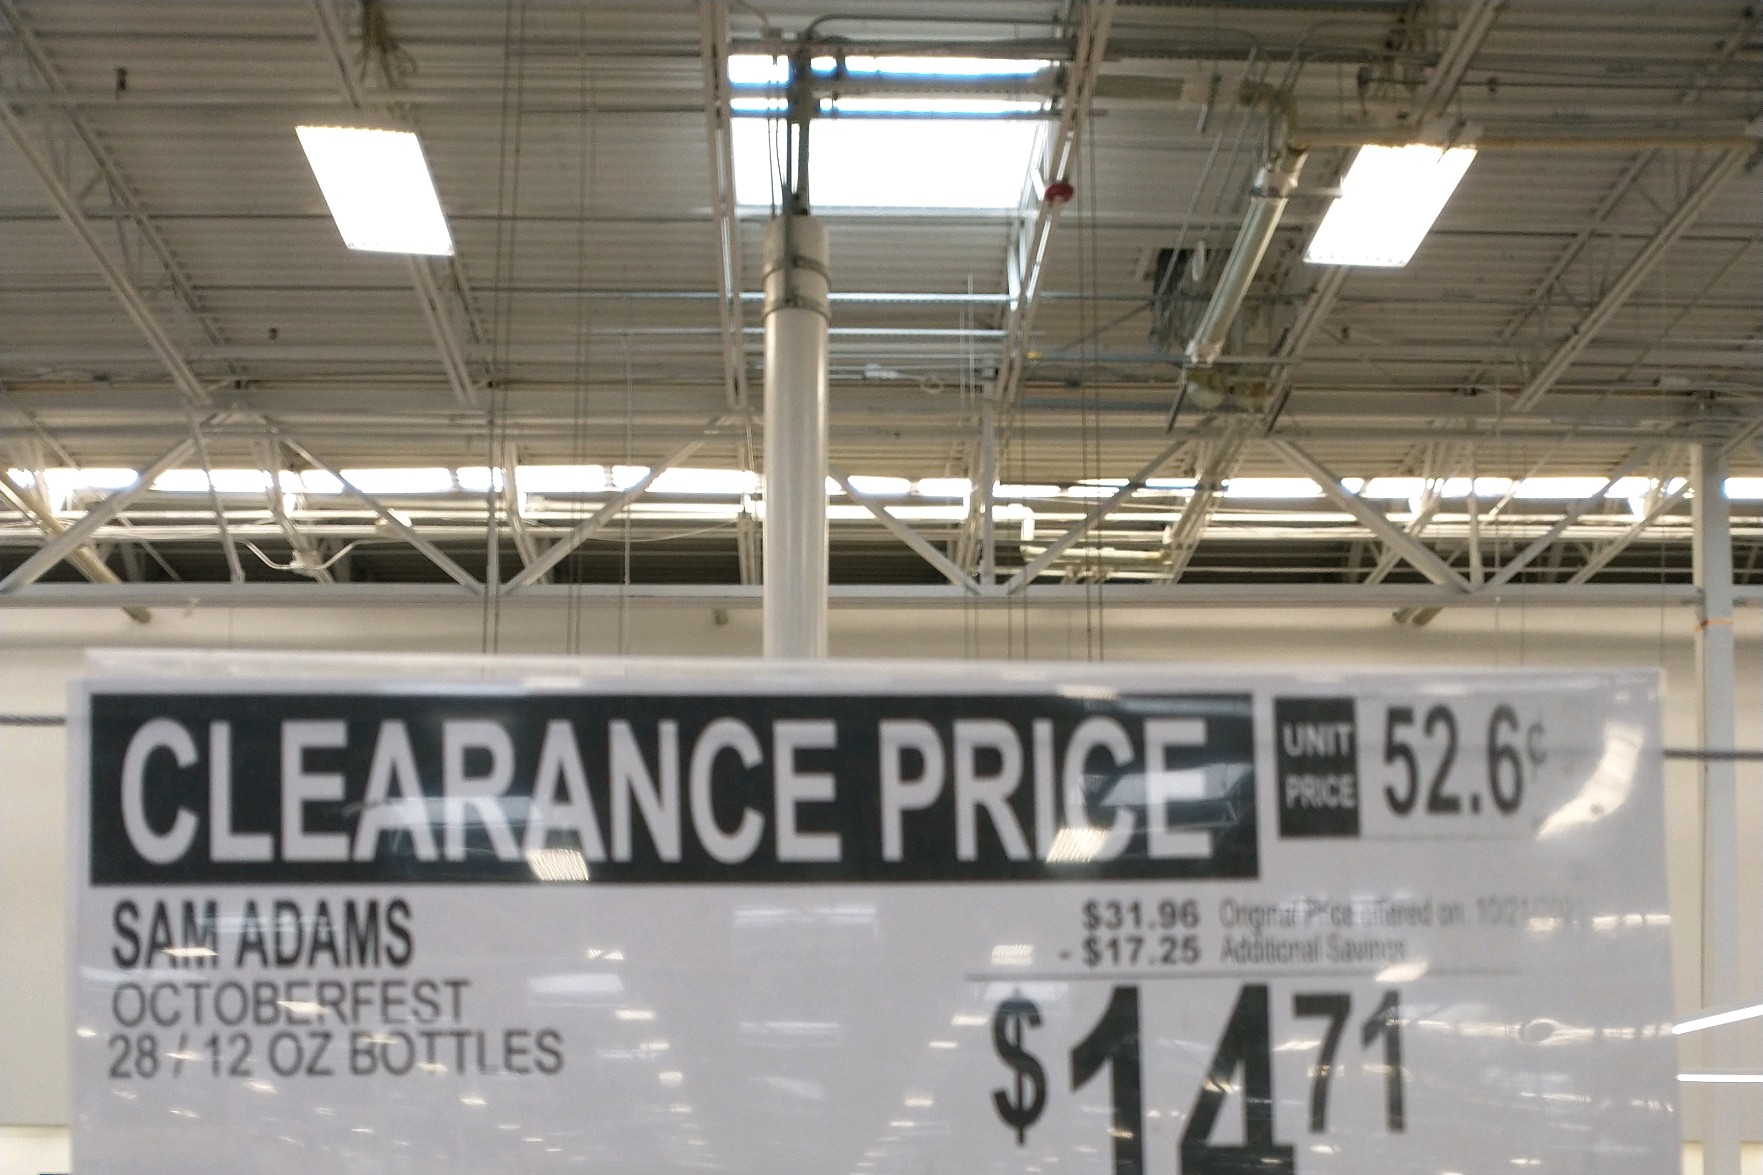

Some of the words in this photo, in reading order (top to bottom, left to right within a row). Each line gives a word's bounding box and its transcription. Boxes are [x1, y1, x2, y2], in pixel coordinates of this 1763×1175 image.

[1282, 722, 1354, 758] UNIT
[120, 716, 843, 866] CLEARANCE
[877, 715, 1214, 864] PRICE
[1284, 774, 1357, 809] PRICE
[111, 899, 217, 969] SAM
[235, 898, 414, 967] ADAMS
[1081, 898, 1200, 932] $31.96
[1081, 934, 1200, 967] $17.25
[111, 979, 471, 1027] OCTOBERFEST
[107, 1032, 161, 1079] 28
[203, 1032, 254, 1078] 12
[267, 1031, 334, 1078] OZ
[350, 1030, 566, 1077] BOTTLES
